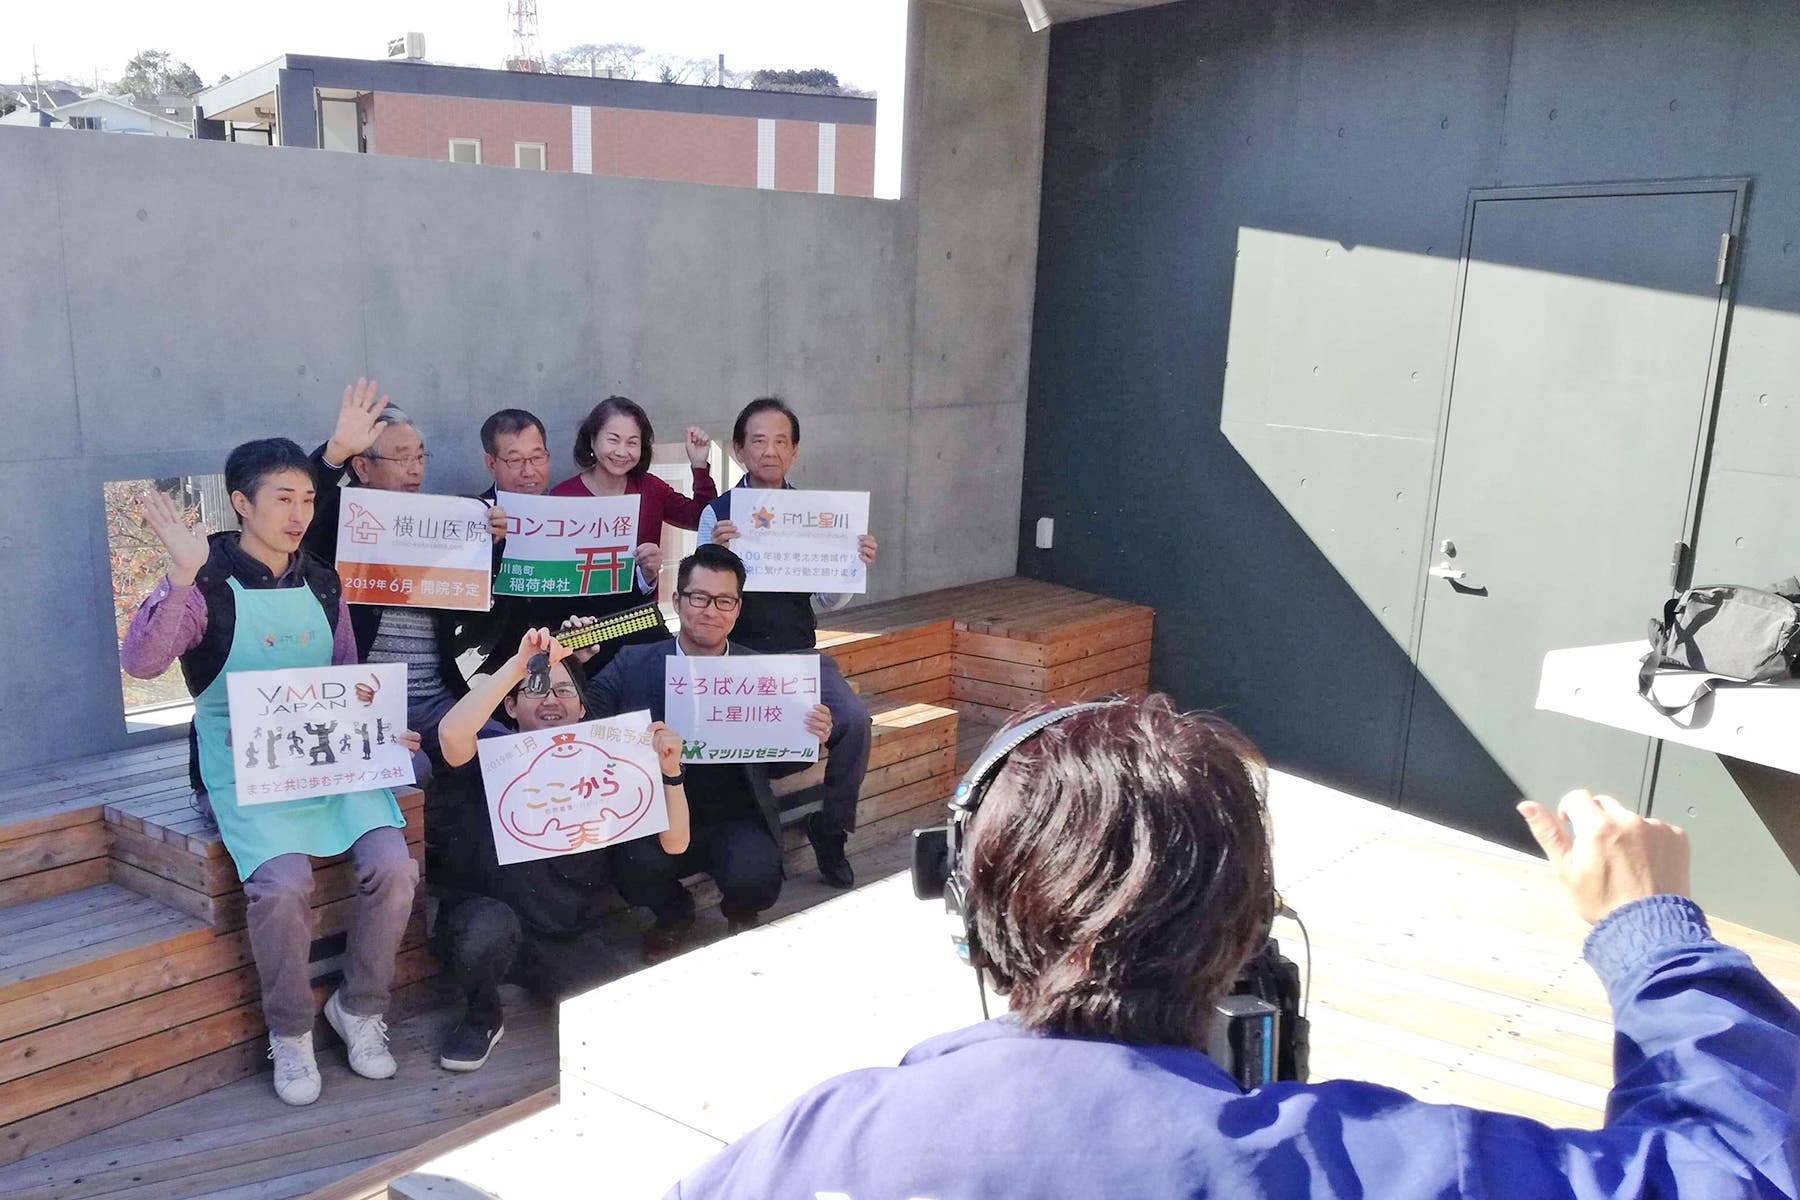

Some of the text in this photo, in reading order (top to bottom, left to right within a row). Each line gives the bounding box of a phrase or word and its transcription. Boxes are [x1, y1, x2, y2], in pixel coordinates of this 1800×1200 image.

[392, 515, 487, 543] 横山医院
[506, 515, 632, 539] コンコン小径
[782, 511, 849, 529] FM上星川
[499, 562, 535, 576] 川島町
[420, 579, 480, 597] 開院予定
[509, 577, 571, 592] 稲荷神社
[257, 682, 346, 703] VMD
[669, 676, 817, 696] そろばん塾ピコ
[258, 699, 347, 716] JAPAN
[706, 705, 783, 723] 上星川校
[590, 723, 653, 746] 開院予定
[708, 747, 815, 760] マツハシゼミナール
[522, 762, 621, 809] ここから
